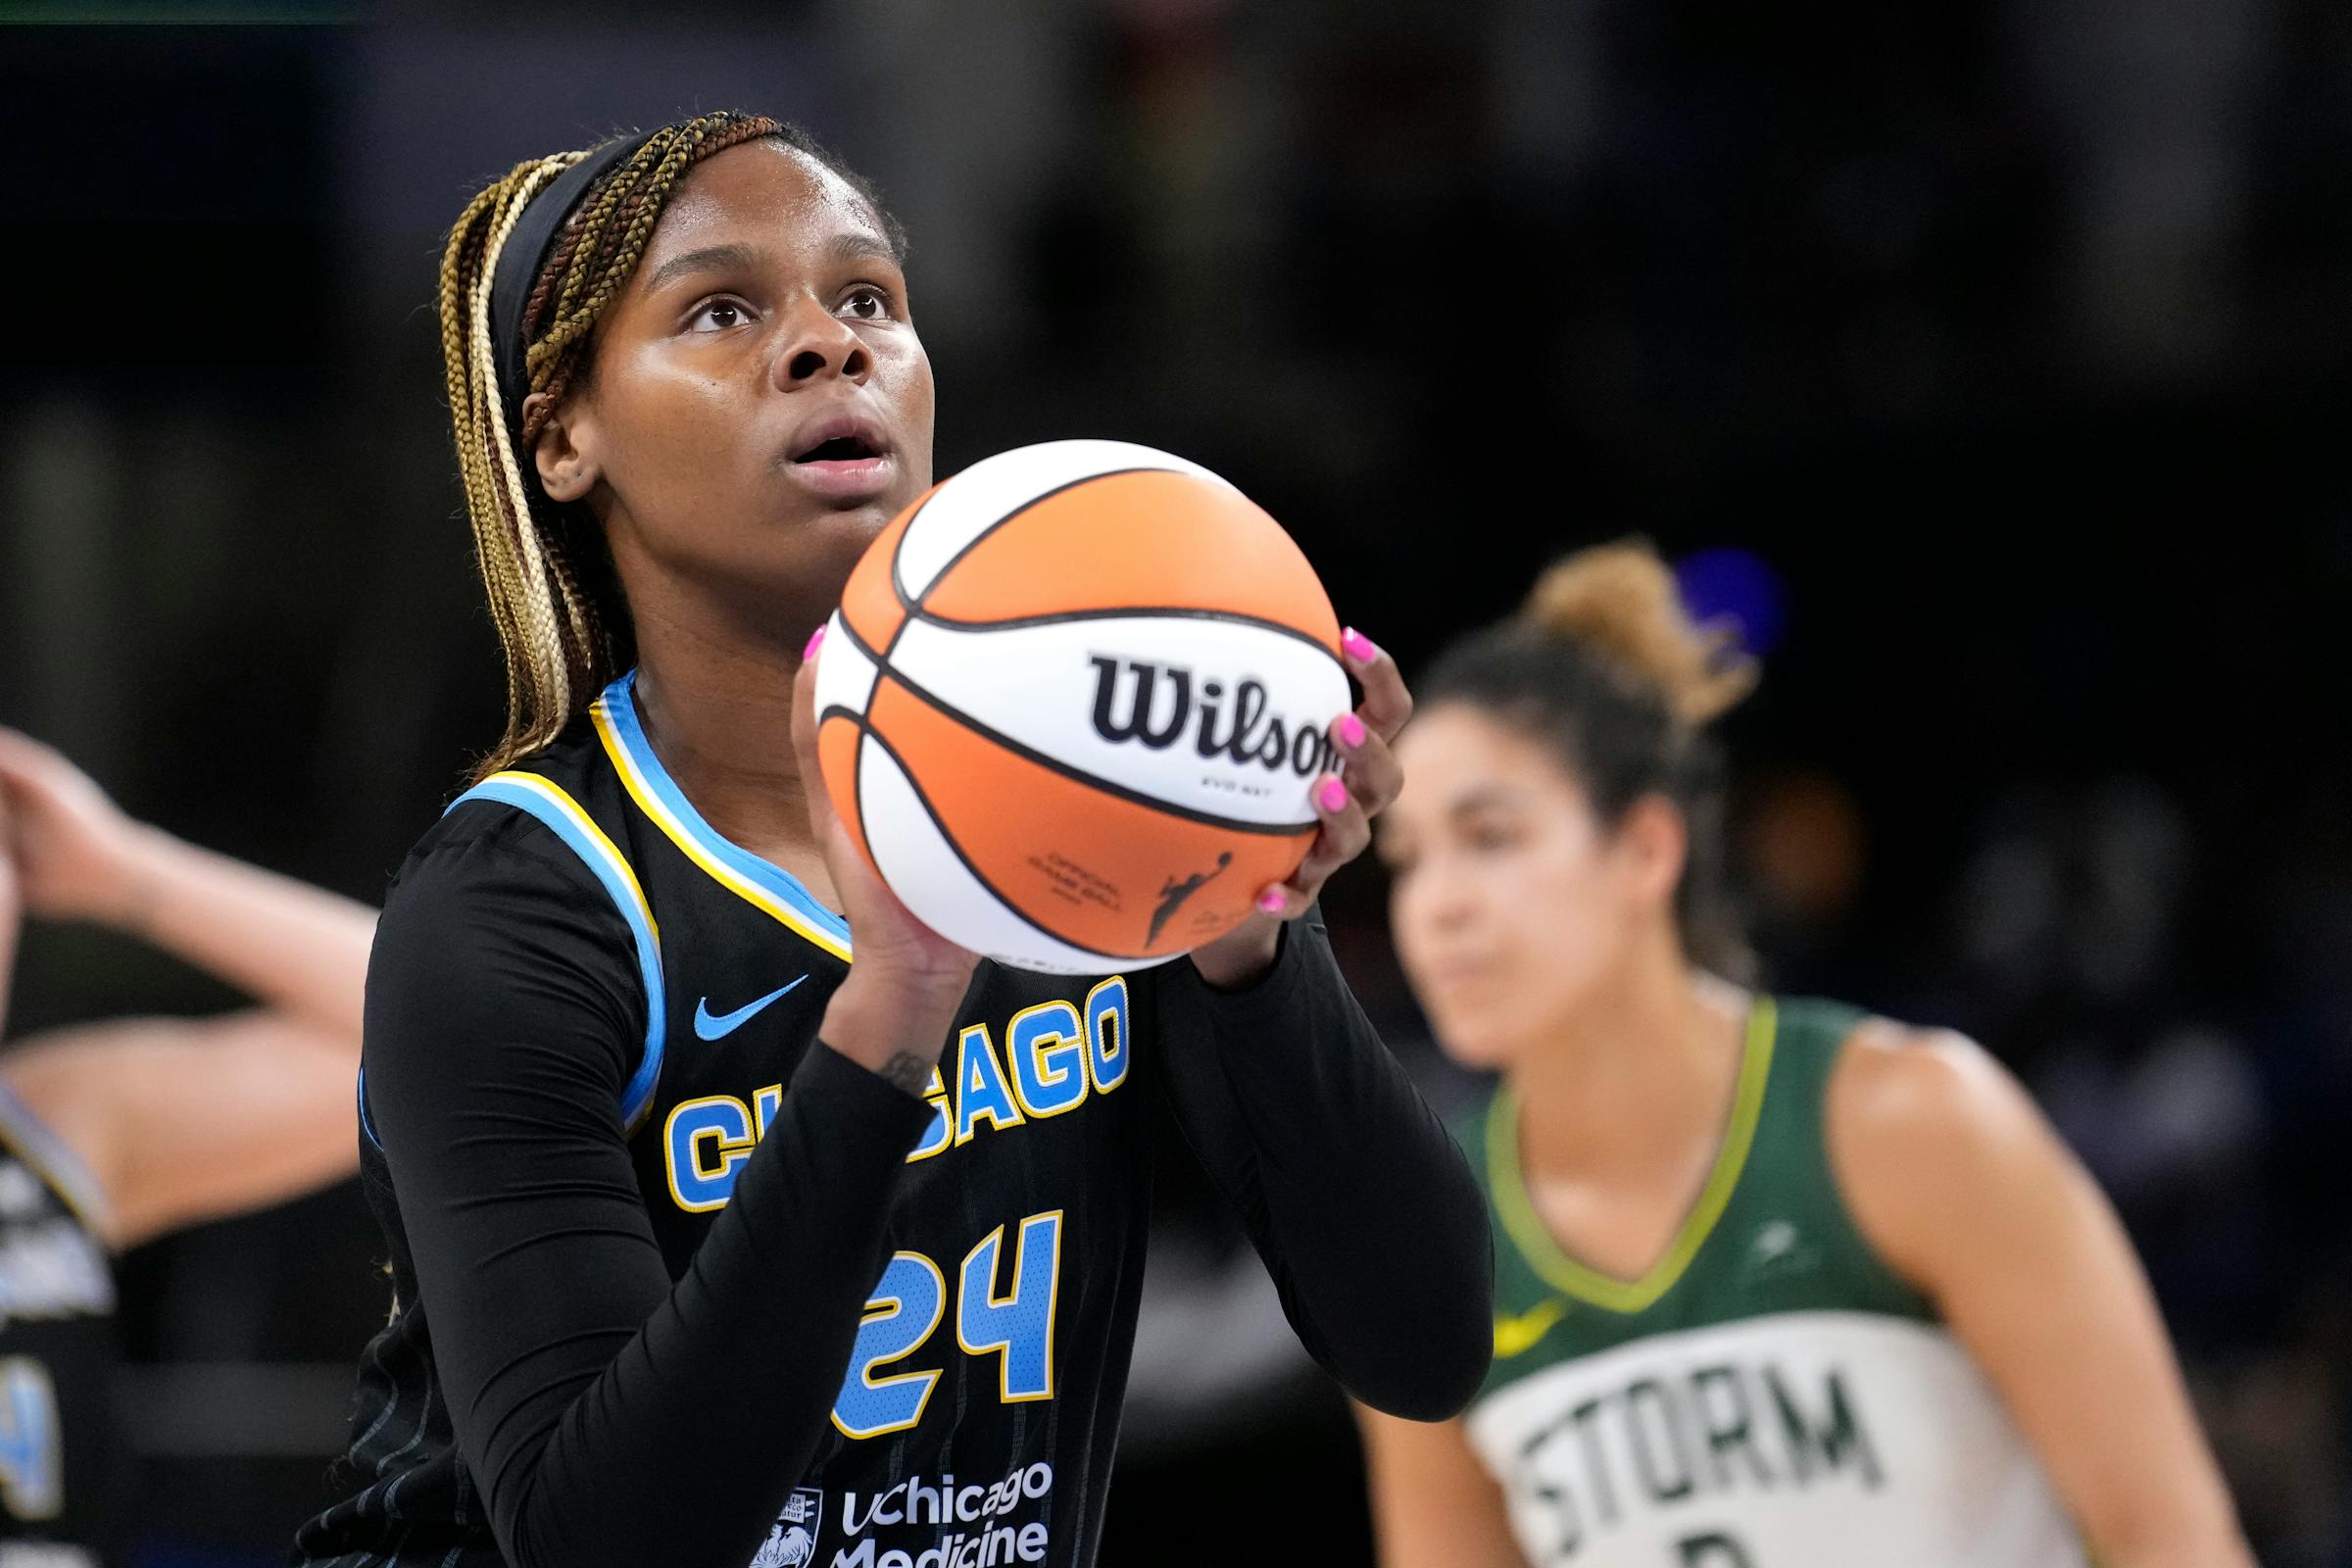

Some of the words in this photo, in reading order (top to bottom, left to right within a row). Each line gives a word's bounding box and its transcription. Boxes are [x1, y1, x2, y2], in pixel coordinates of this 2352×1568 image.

[663, 975, 1130, 1213] CAGO
[830, 1209, 1063, 1440] 24
[830, 1521, 1049, 1568] Medicine
[843, 1462, 1054, 1537] UChicago
[1518, 1361, 1884, 1558] STORM
